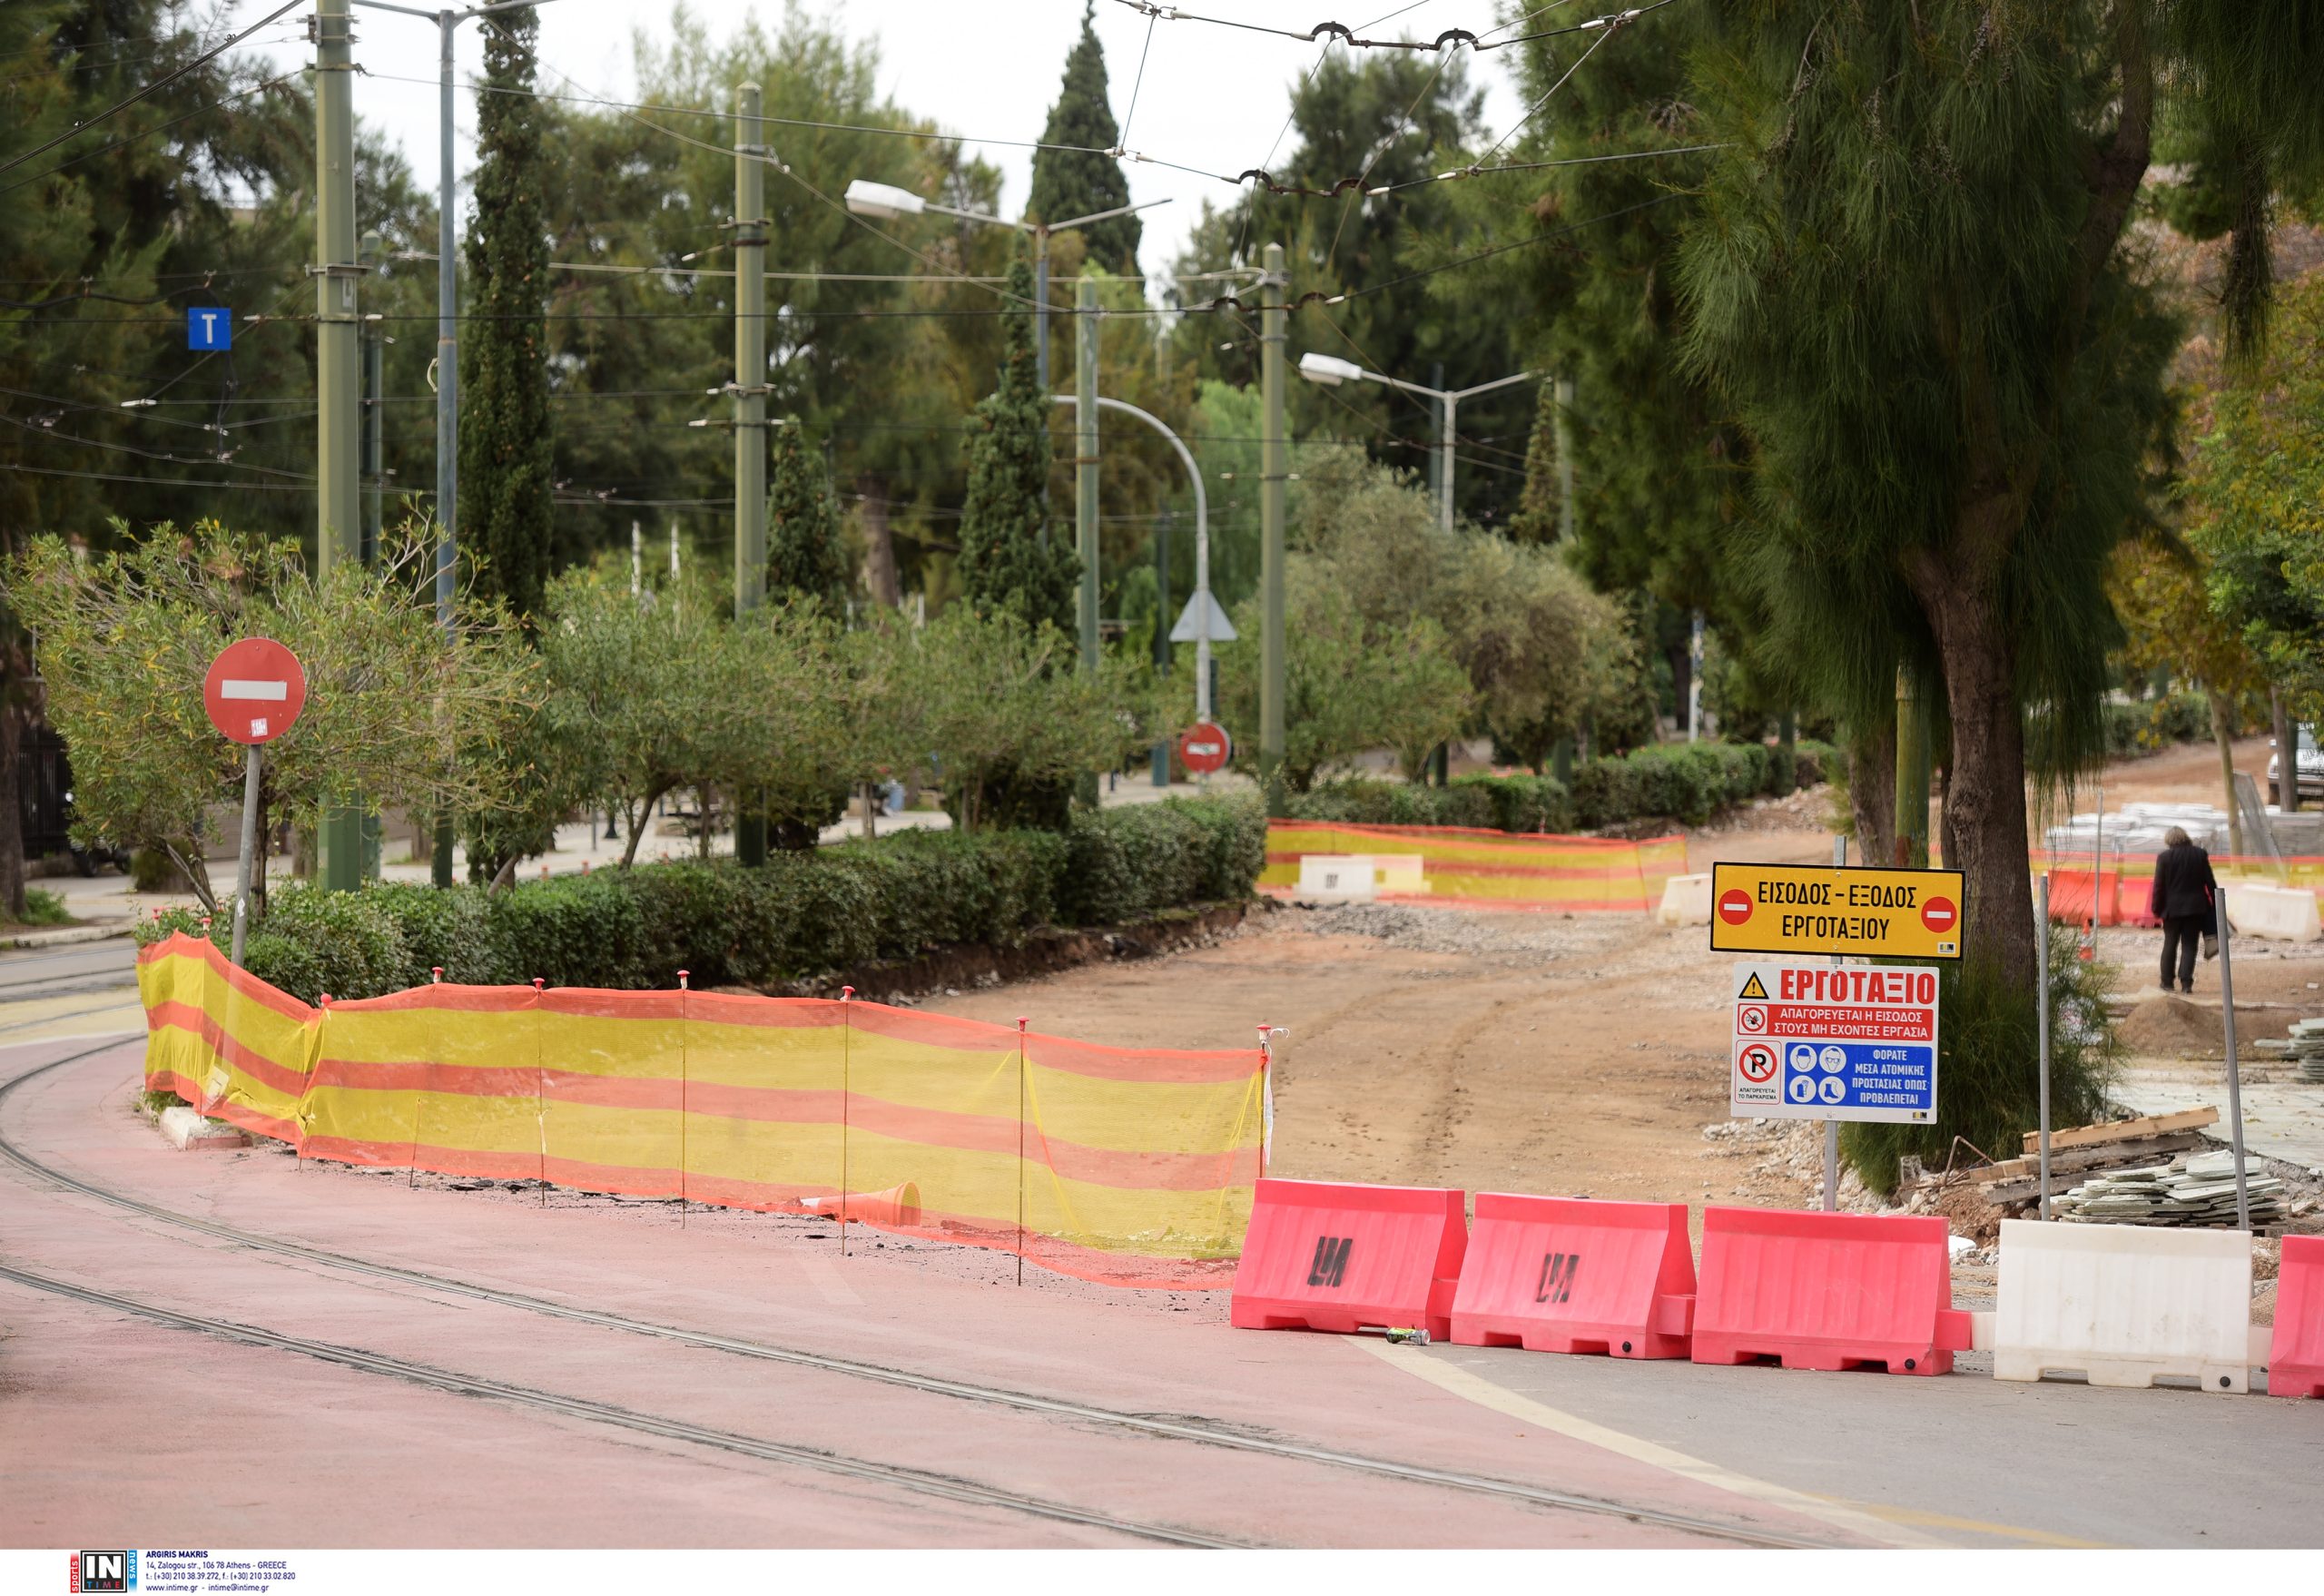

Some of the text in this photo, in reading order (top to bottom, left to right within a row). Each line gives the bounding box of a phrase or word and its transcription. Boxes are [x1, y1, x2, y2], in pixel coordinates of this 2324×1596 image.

[202, 314, 217, 344] T
[1758, 881, 1831, 905] ΕΙΣΟΔΟΣ
[1848, 884, 1917, 909] ΕΞΟΔΟΣ
[1782, 914, 1890, 941] ΕΡΓΟΤΑΞΙΟΥ
[1780, 969, 1935, 1005] ΕΡΓΟΤΑΞΙΟ
[1780, 1008, 1923, 1023] ΑΠΑΓΟΡΕΥΕΤΑΙ Η ΕΙΣΟΔΟΣ
[1774, 1022, 1928, 1038] ΣΤΟΥΣ ΜΗ ΕΧΟΝΤΕΣ ΕΡΓΑΣΙΑ
[1873, 1049, 1907, 1061] ΦΟΡΑΤΕ
[1855, 1063, 1925, 1076] ΜΕΣΑ ΑΤΟΜΙΚΗΣ
[1852, 1077, 1927, 1091] ΠΡΟΣΤΑΣΙΑΣ ΟΠΩΣ
[1860, 1092, 1919, 1105] ΠΡΟΒΛΕΠΕΤΑΙ
